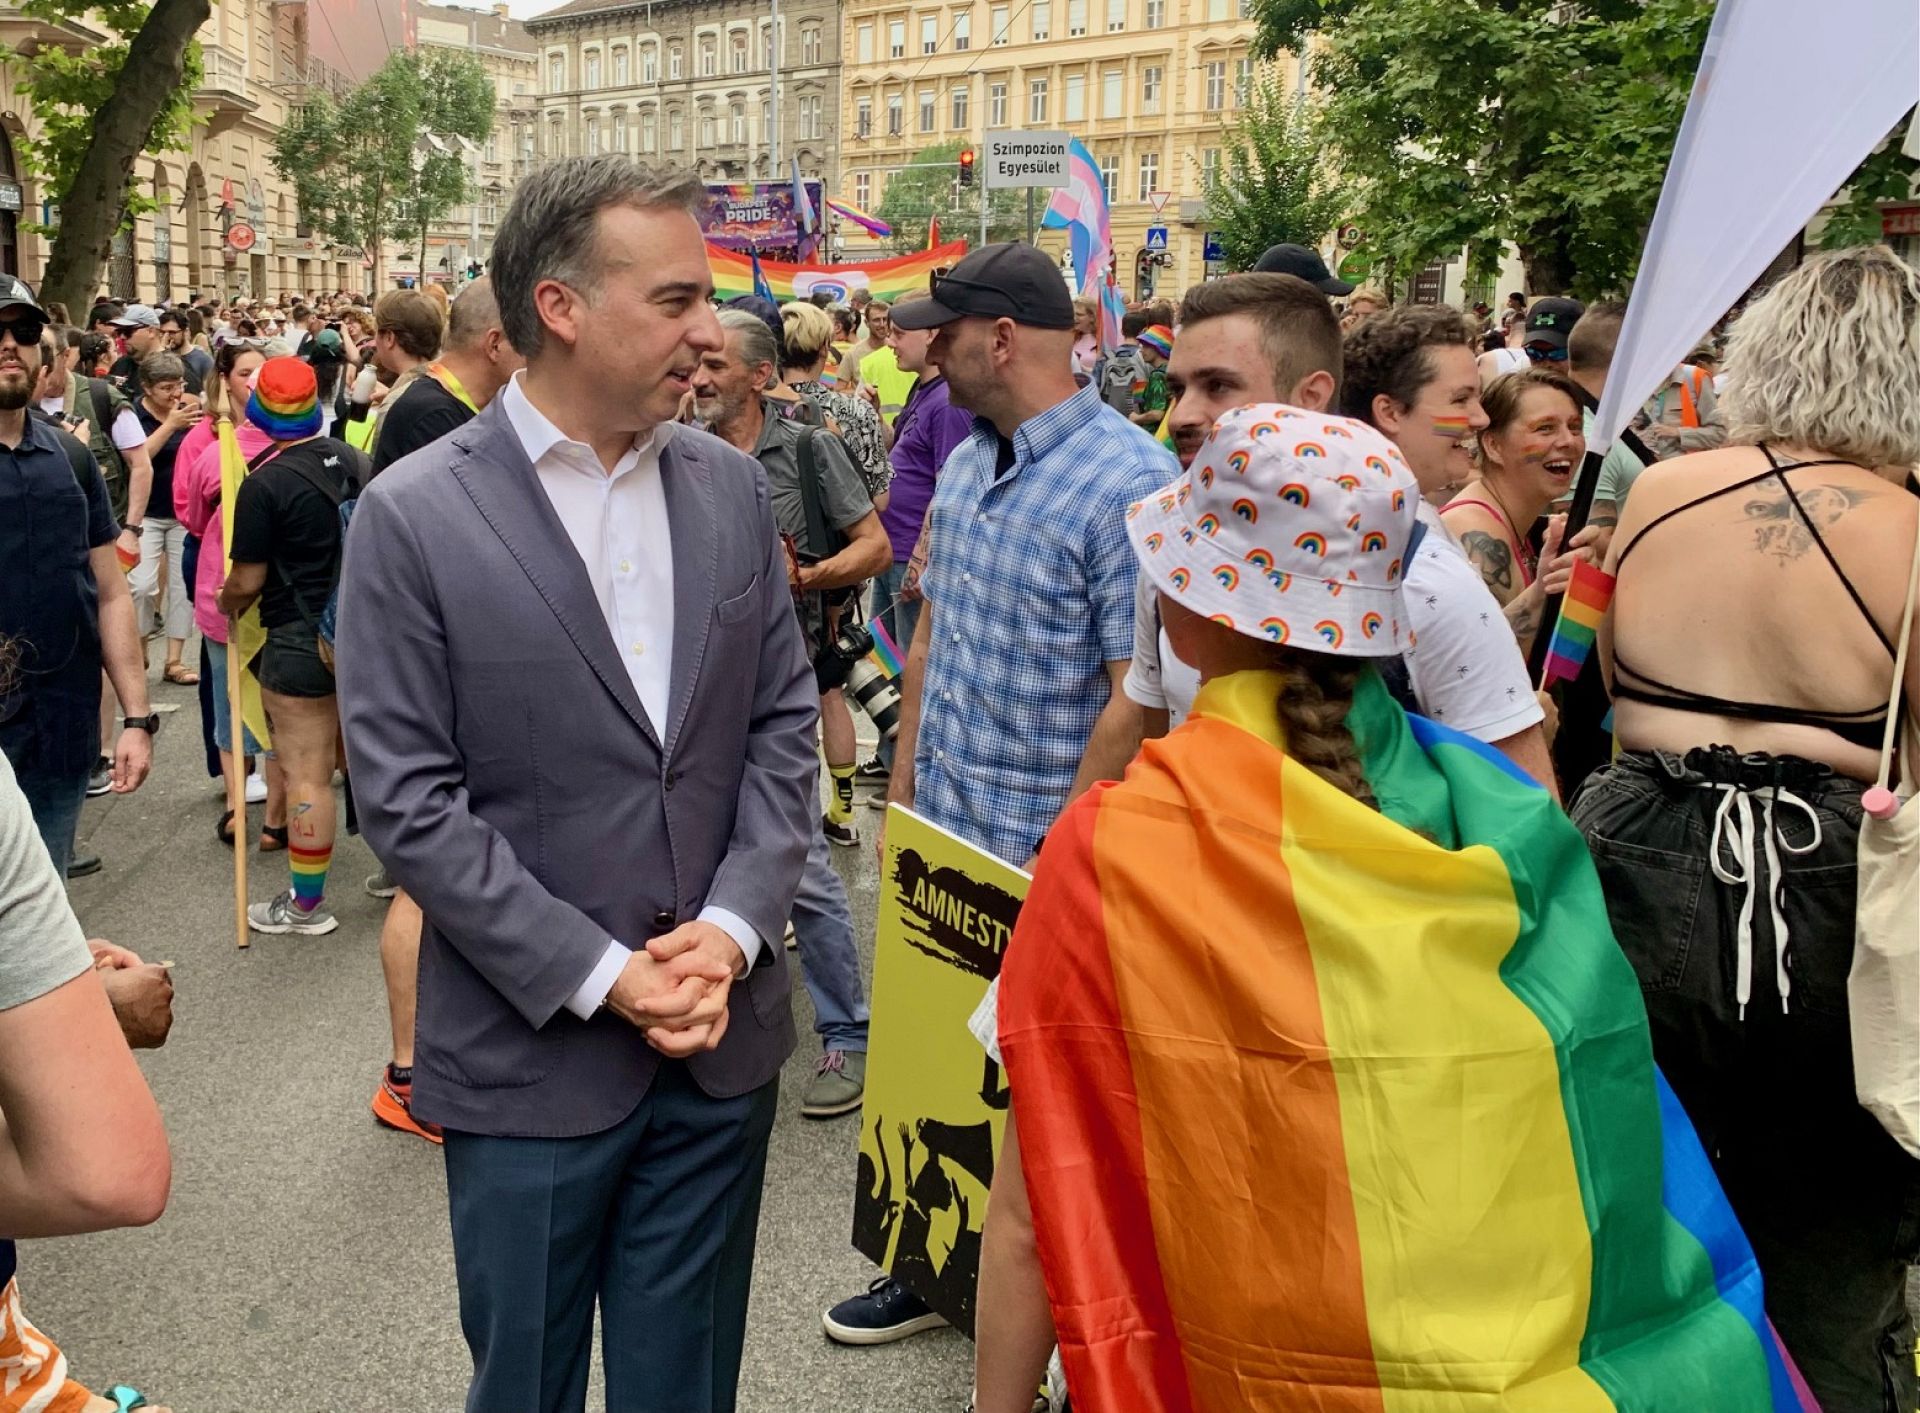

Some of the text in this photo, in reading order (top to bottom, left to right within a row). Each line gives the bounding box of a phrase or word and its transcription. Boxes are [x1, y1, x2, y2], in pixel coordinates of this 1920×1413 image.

[993, 141, 1065, 157] Szimpozion
[999, 160, 1060, 176] Egyesület
[729, 200, 768, 209] BUDAPEST
[726, 208, 772, 223] PRIDE
